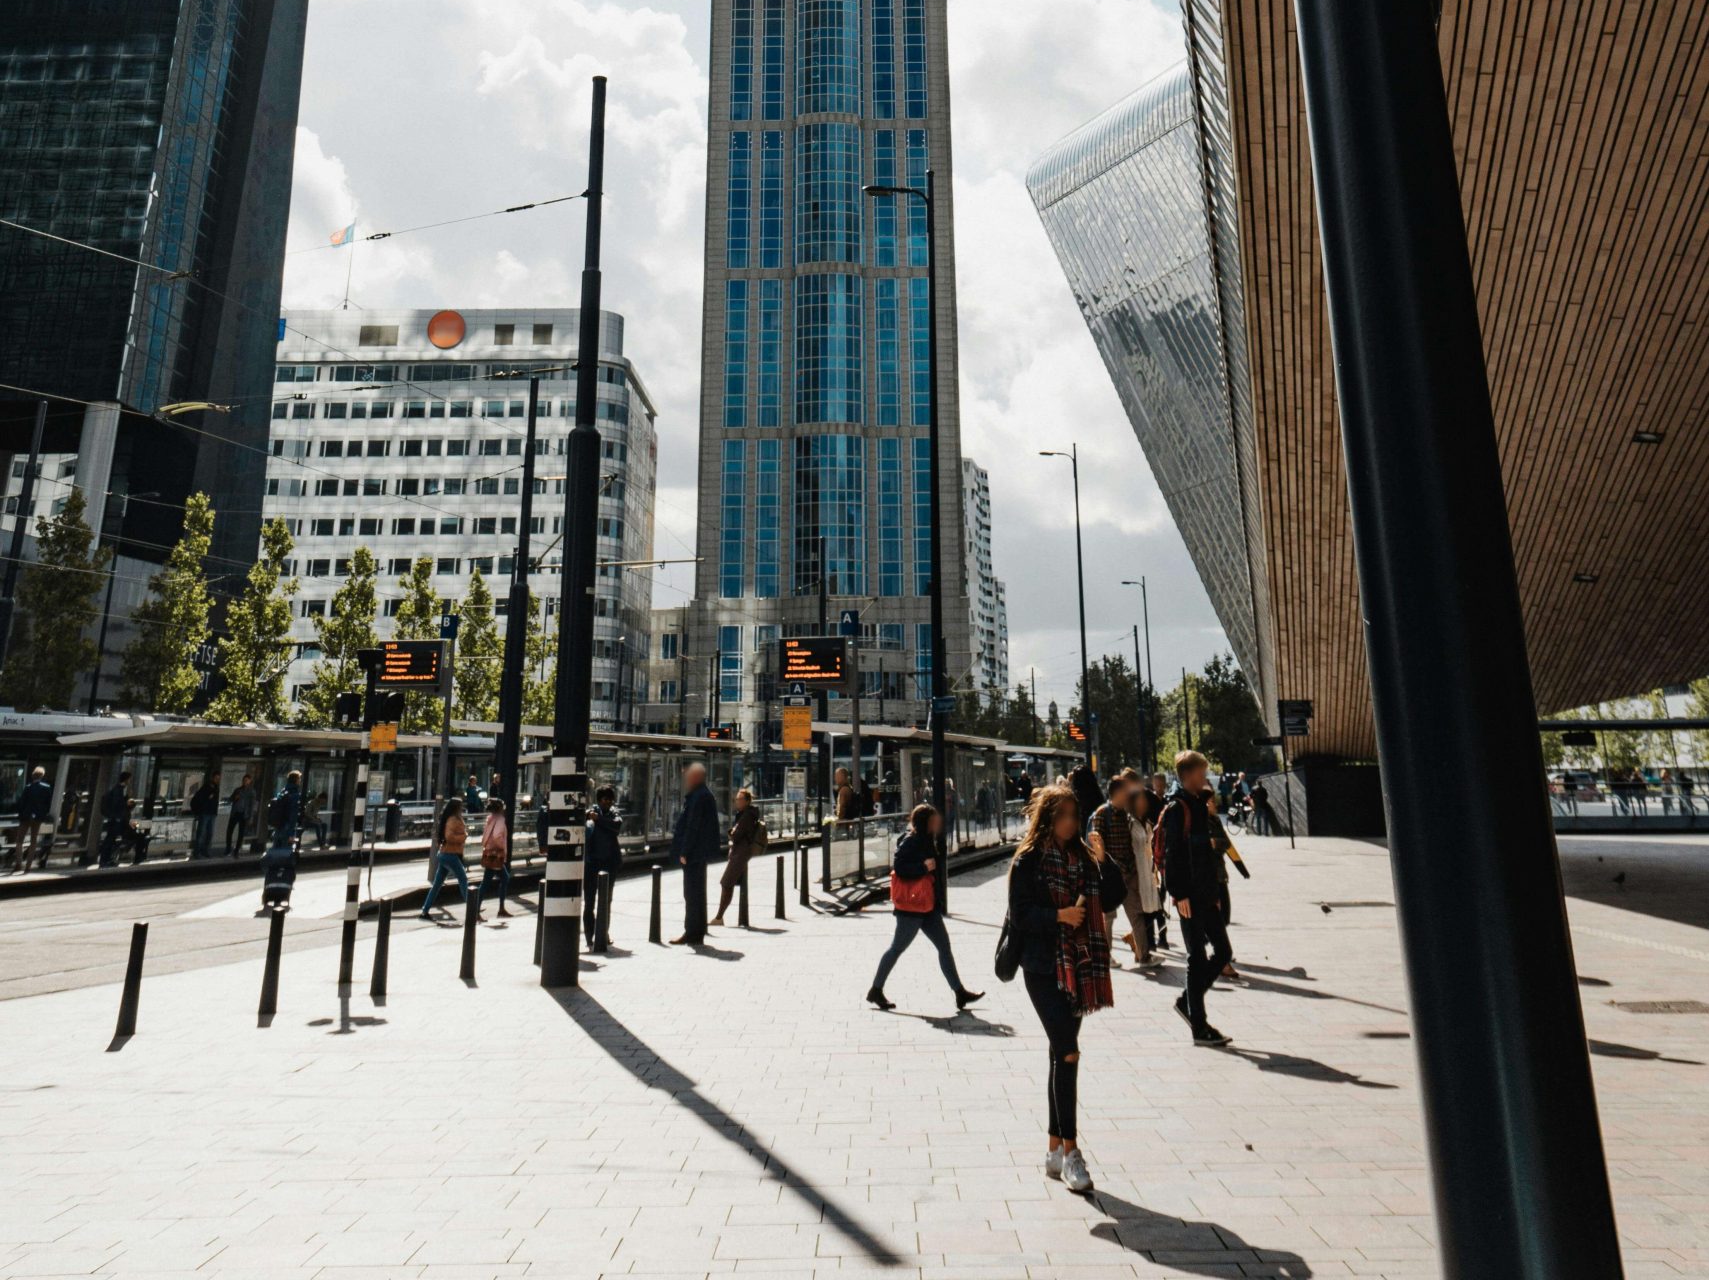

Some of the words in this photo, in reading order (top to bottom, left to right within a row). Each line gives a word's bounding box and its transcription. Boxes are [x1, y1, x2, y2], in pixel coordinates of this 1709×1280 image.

[443, 616, 451, 627] B
[843, 612, 852, 624] A
[793, 683, 802, 694] A
